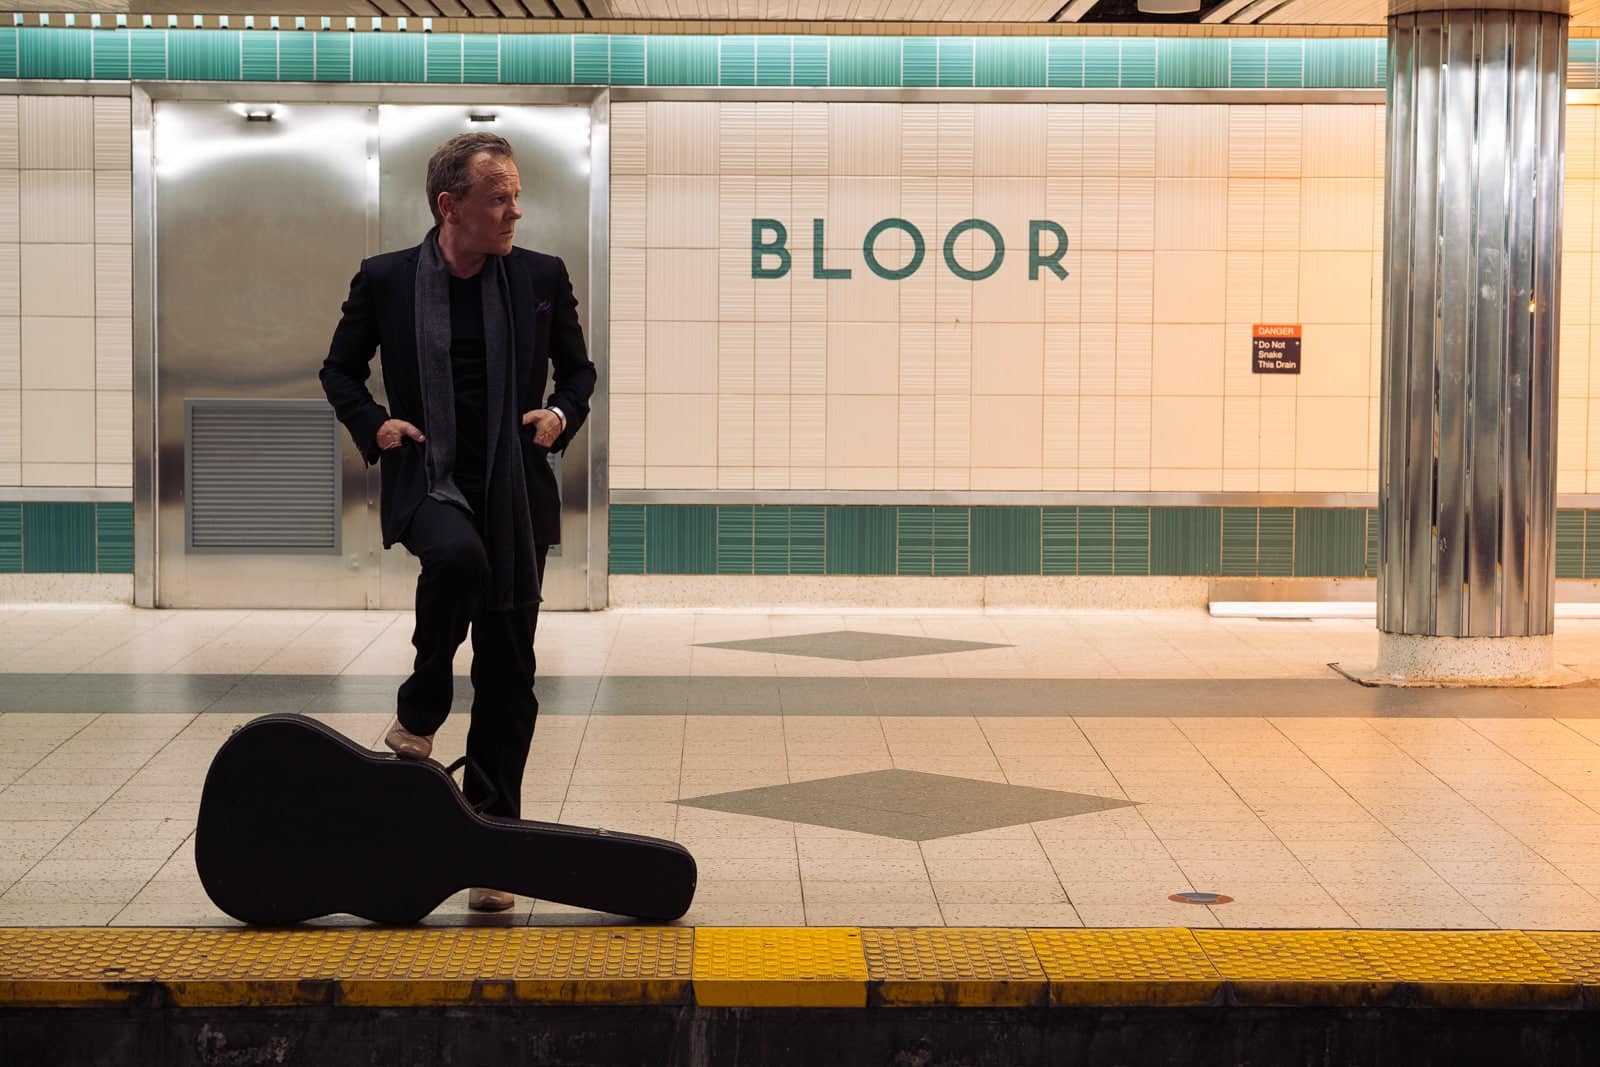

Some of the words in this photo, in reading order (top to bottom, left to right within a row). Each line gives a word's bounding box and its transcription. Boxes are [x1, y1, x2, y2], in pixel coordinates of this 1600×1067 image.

[751, 217, 1069, 281] BLOOR
[1258, 327, 1294, 336] DANGER
[1258, 340, 1270, 349] Do
[1271, 340, 1286, 349] Not
[1258, 350, 1283, 359] Snake
[1257, 360, 1275, 369] This
[1275, 360, 1297, 369] Drain
